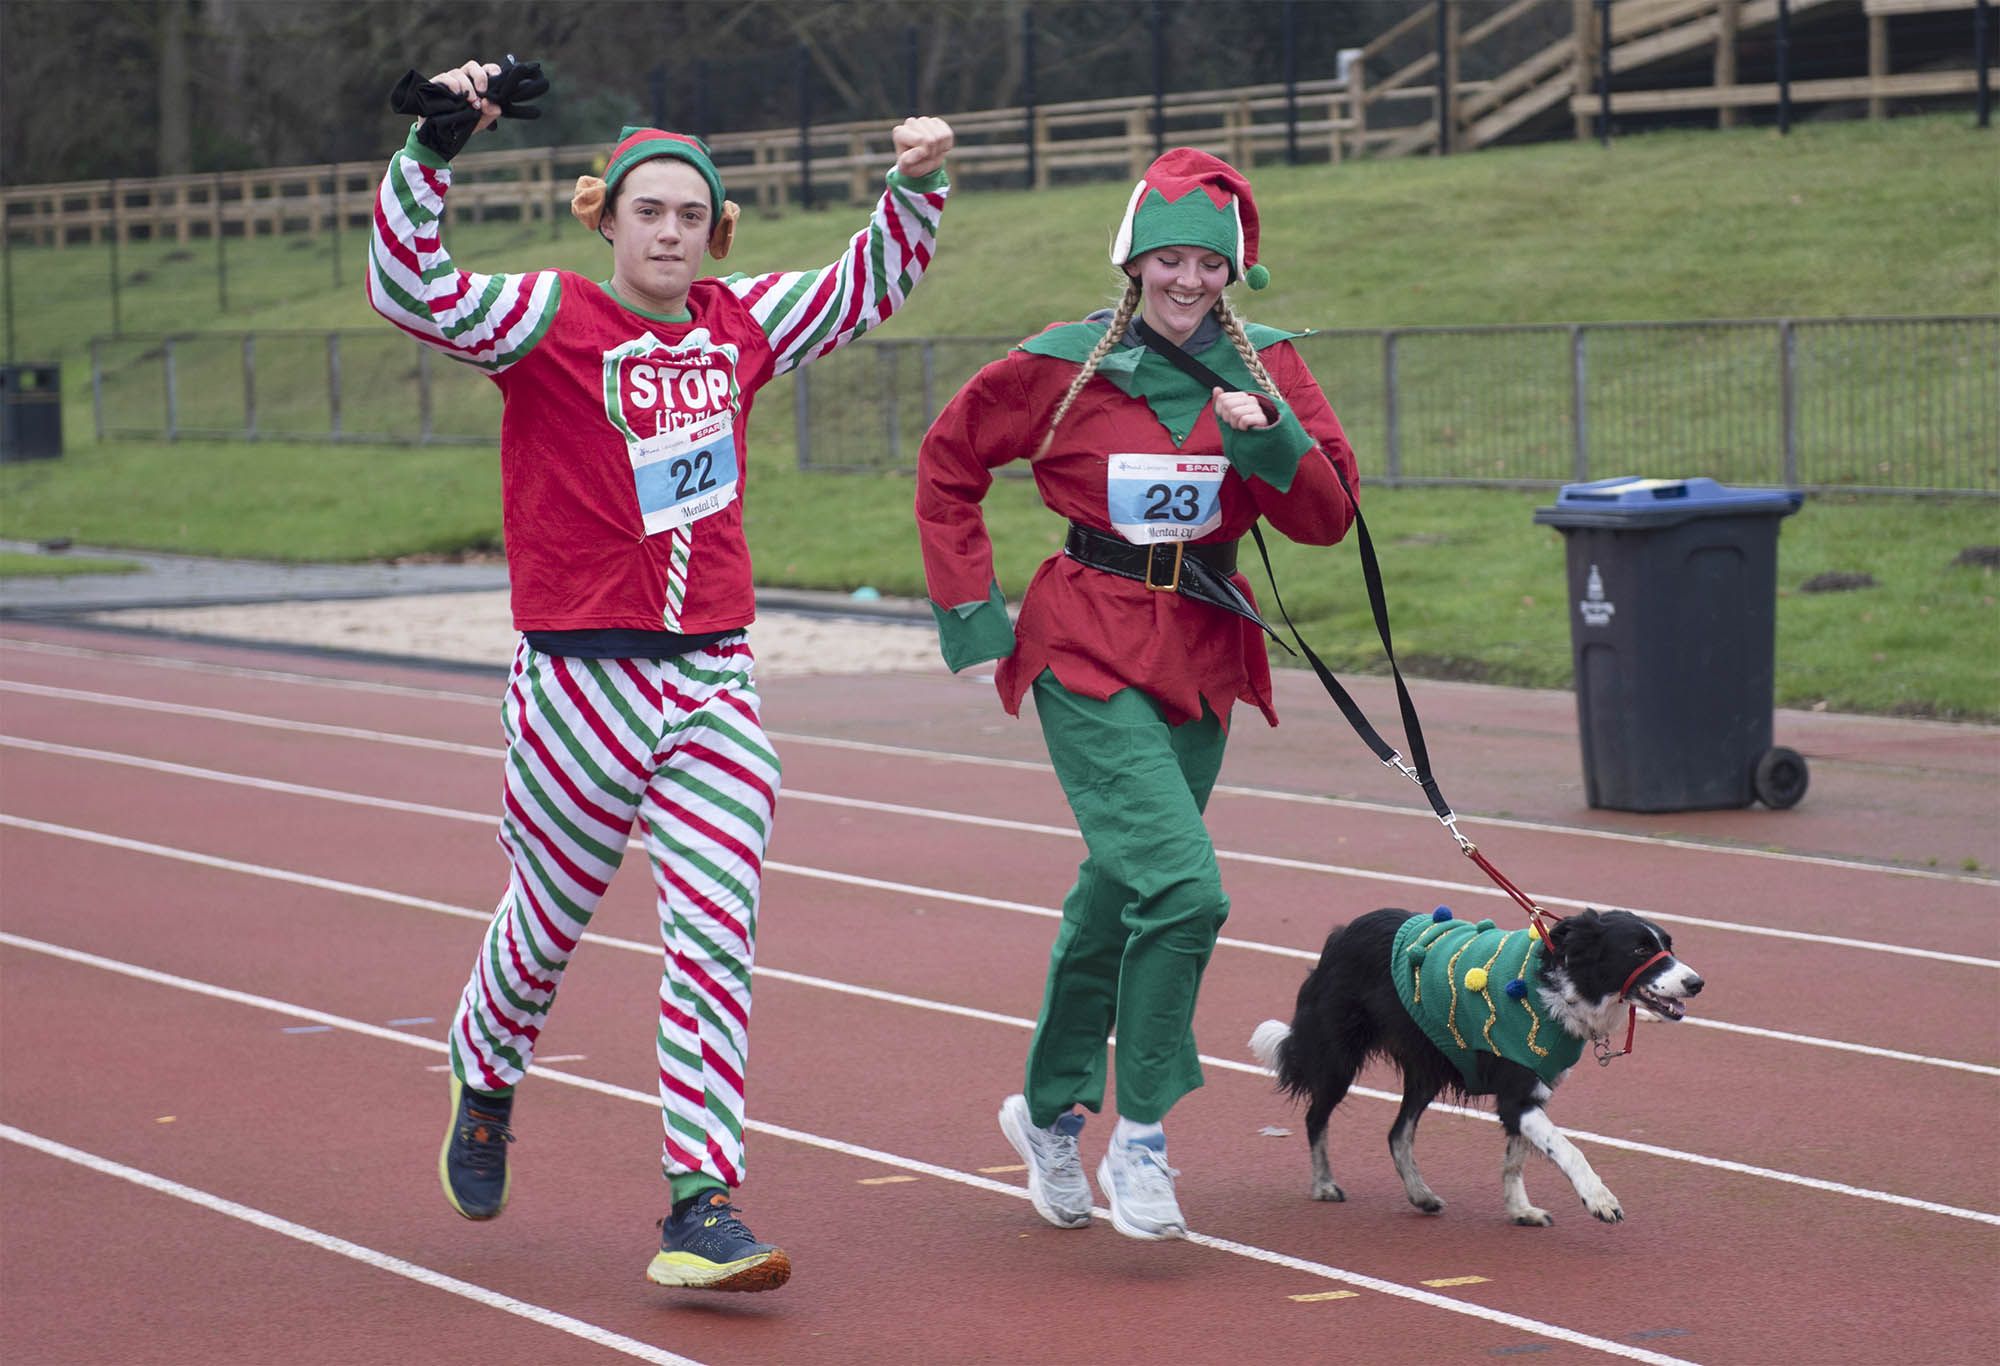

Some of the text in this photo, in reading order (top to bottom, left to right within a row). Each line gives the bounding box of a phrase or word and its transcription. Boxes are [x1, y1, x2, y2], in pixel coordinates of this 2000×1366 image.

[630, 364, 729, 410] STOP
[696, 424, 720, 438] SPAR
[670, 449, 717, 501] 22
[1185, 464, 1218, 472] SPAR
[681, 499, 710, 519] Mental
[1144, 483, 1200, 522] 23
[1180, 527, 1195, 539] Elf
